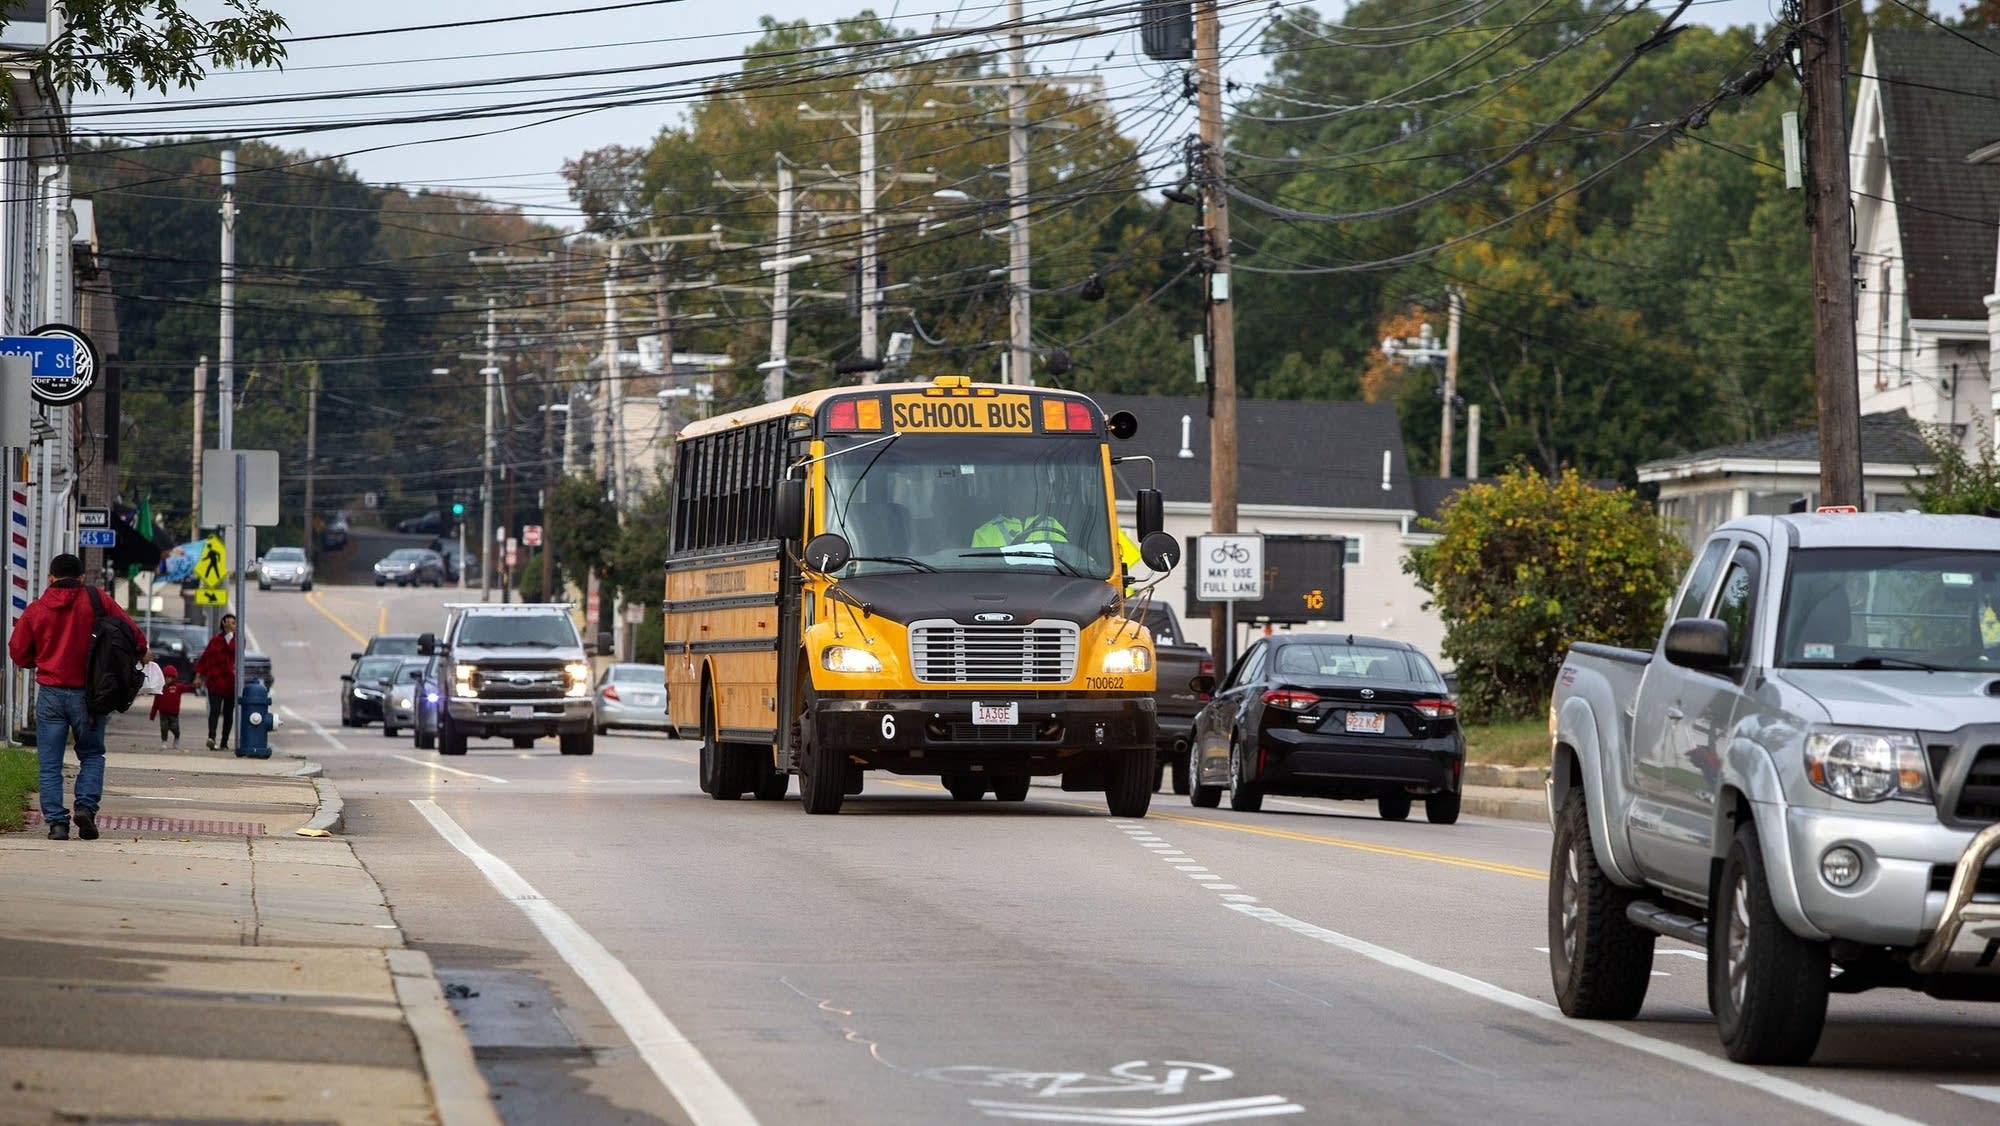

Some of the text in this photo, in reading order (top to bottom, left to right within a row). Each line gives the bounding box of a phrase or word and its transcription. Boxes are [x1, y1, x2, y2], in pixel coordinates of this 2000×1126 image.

[55, 353, 71, 368] St
[893, 403, 1031, 428] SCHOOL BUS
[1208, 568, 1252, 578] MAY USE
[1203, 582, 1257, 592] FULL LANE
[1086, 677, 1124, 689] 7100622
[979, 707, 1010, 719] 1A3GE
[881, 714, 895, 739] 6
